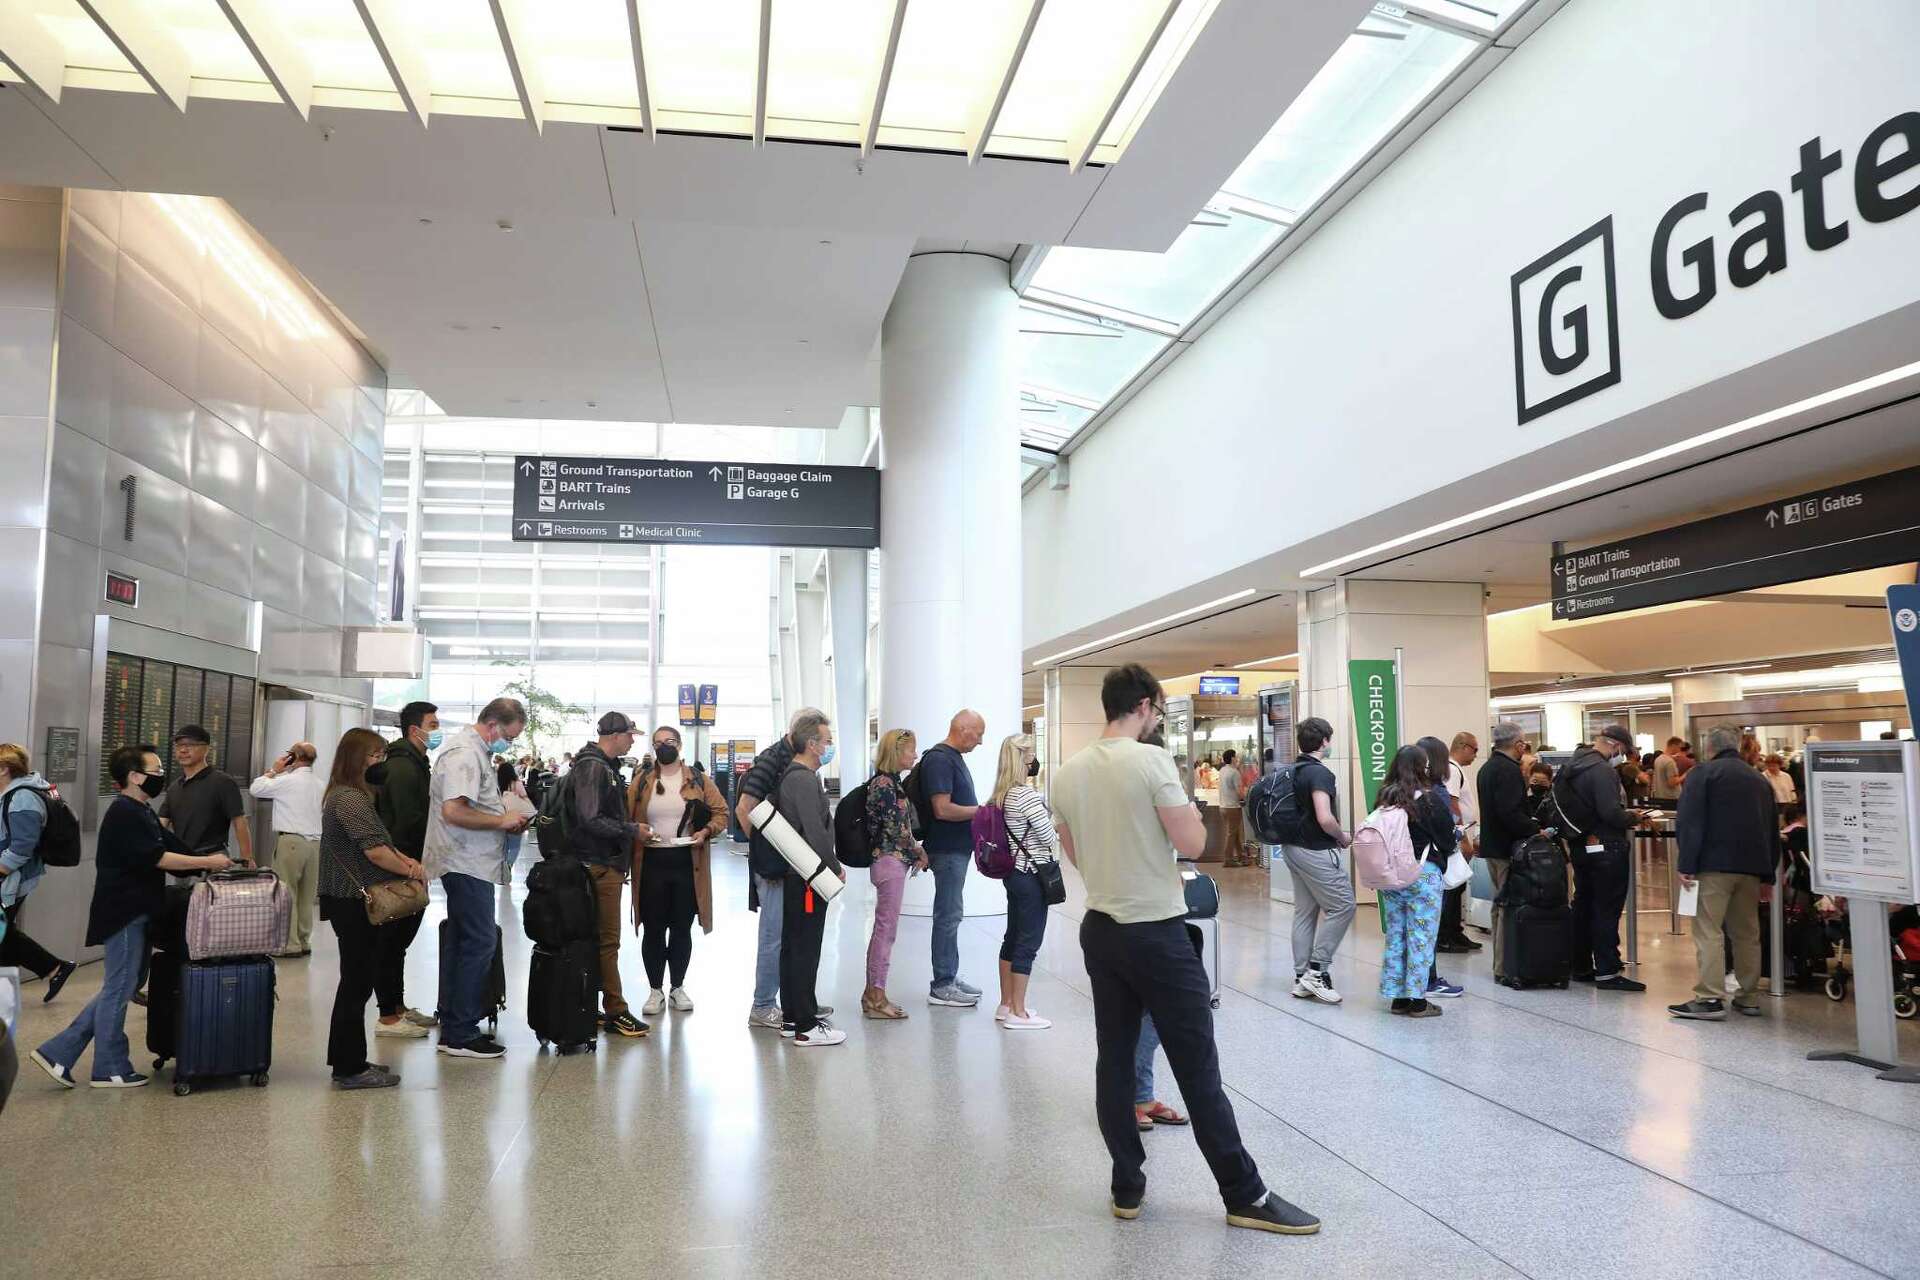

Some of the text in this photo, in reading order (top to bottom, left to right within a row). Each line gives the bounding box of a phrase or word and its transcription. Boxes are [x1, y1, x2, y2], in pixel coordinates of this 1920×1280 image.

[1538, 111, 1920, 376] G Gate
[560, 464, 693, 479] Ground Transportation
[747, 469, 832, 483] Baggage Claim
[559, 481, 631, 494] BART Trains
[747, 486, 788, 500] Garage
[790, 488, 800, 499] G
[558, 499, 606, 511] Arrivals
[1822, 493, 1863, 512] Gates
[554, 524, 608, 536] Restrooms
[635, 526, 702, 538] Medical Clinic
[1578, 549, 1630, 569] BART Trains
[1579, 557, 1681, 587] Ground Transportation
[1576, 595, 1615, 610] Restrooms
[1368, 674, 1387, 780] CHECKPOINT
